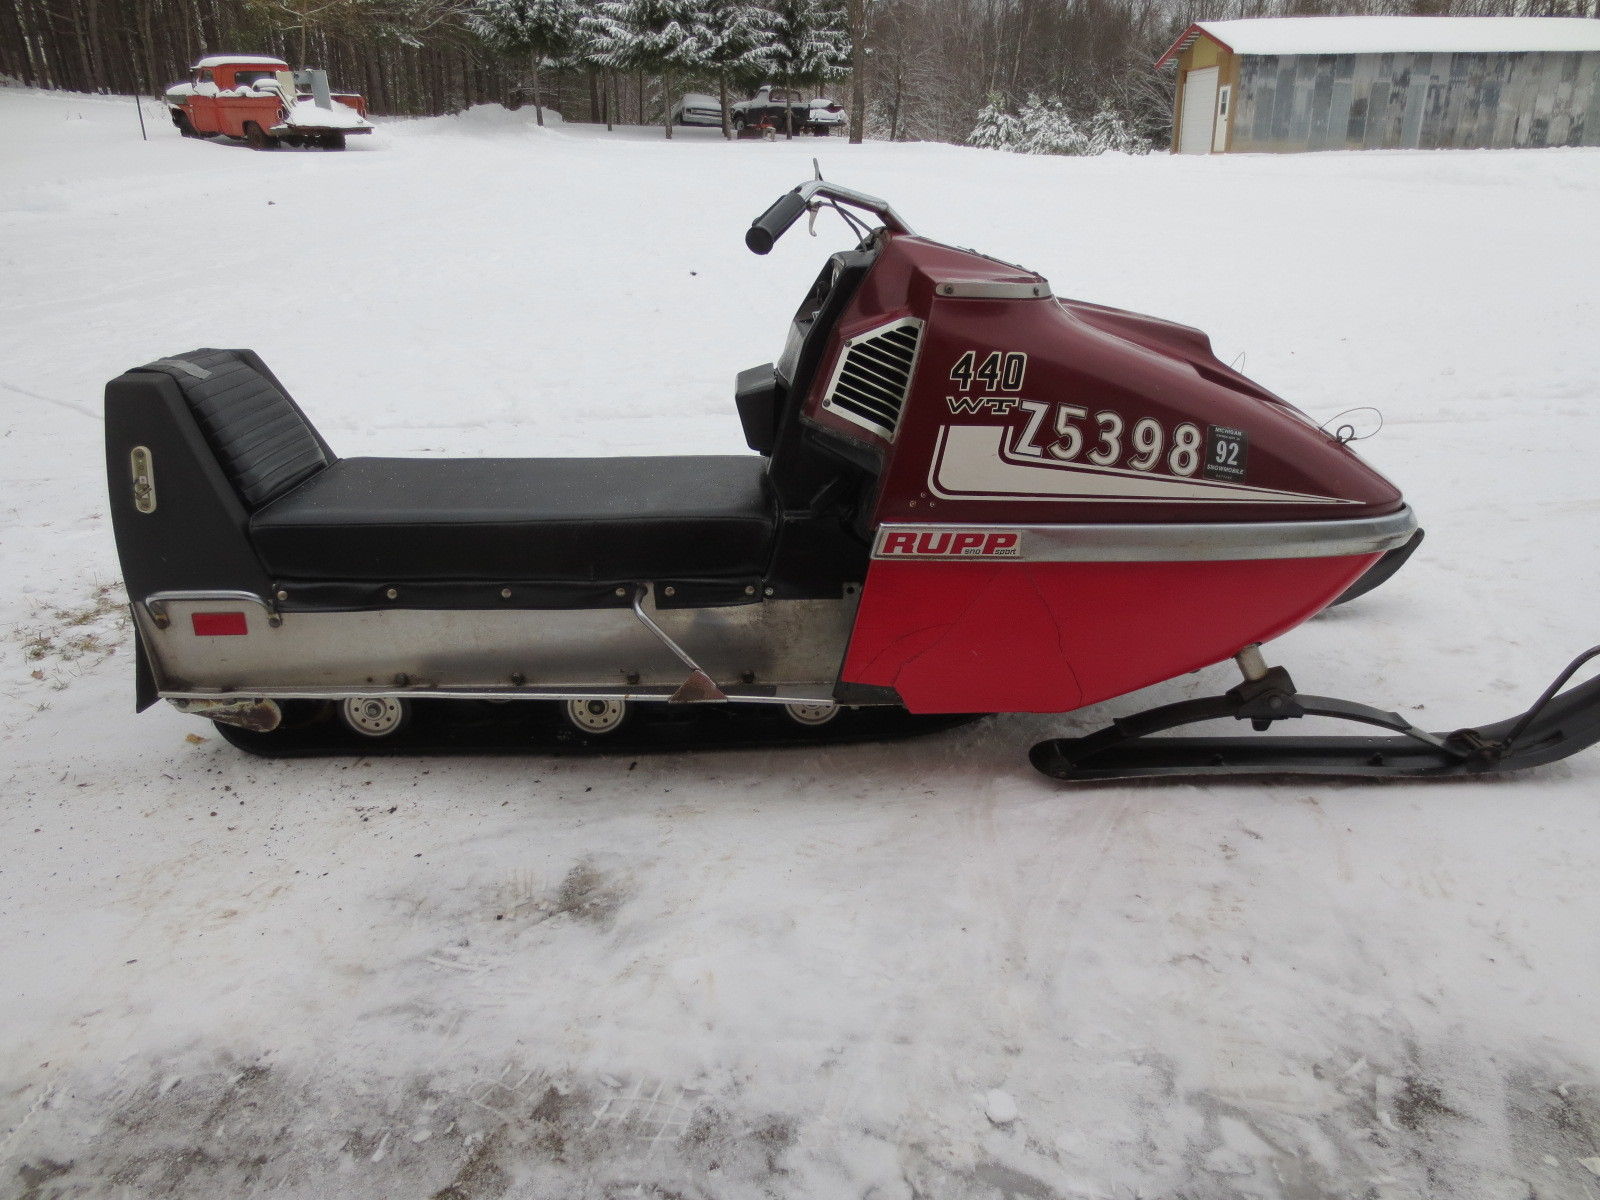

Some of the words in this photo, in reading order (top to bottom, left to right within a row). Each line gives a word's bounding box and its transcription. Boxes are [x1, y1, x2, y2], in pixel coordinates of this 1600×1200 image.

[950, 351, 1027, 391] 440
[946, 396, 1019, 415] WT
[1014, 400, 1201, 477] Z5398
[1215, 427, 1242, 436] MICHIGAN
[1216, 440, 1239, 465] 92
[1207, 464, 1244, 475] SNOWMOBILE
[882, 532, 1018, 555] RUPP
